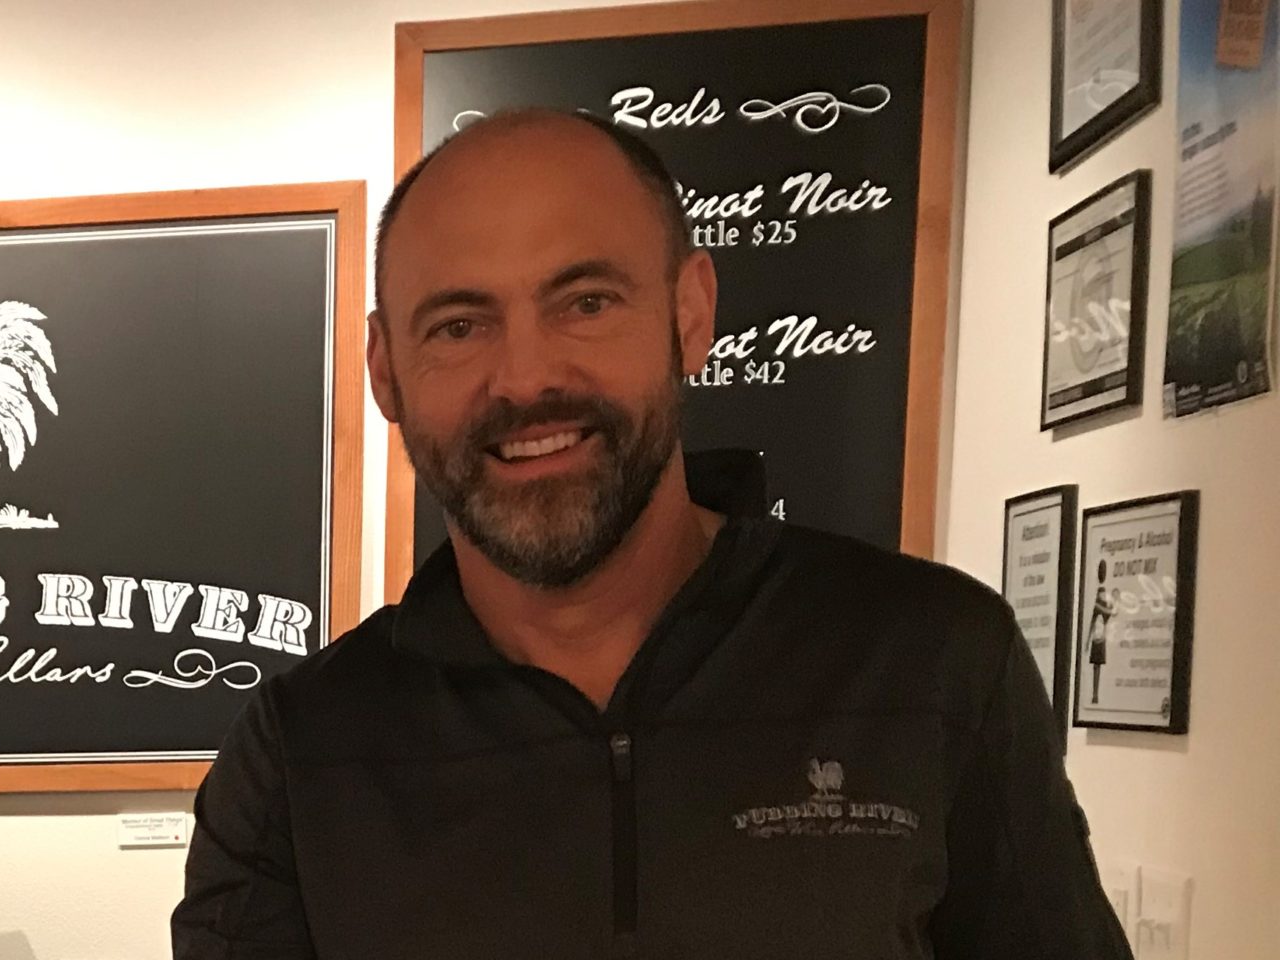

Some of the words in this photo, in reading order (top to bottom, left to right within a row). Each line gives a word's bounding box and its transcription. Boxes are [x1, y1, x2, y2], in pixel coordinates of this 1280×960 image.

[611, 86, 724, 129] Reds
[675, 181, 764, 219] inot
[781, 172, 892, 216] Noir
[692, 220, 740, 247] ttle
[752, 220, 797, 246] $25
[767, 315, 877, 358] Noir
[744, 359, 785, 384] $42
[37, 573, 314, 656] RIVER
[733, 802, 843, 829] PUDDING
[850, 803, 920, 830] RIVER
